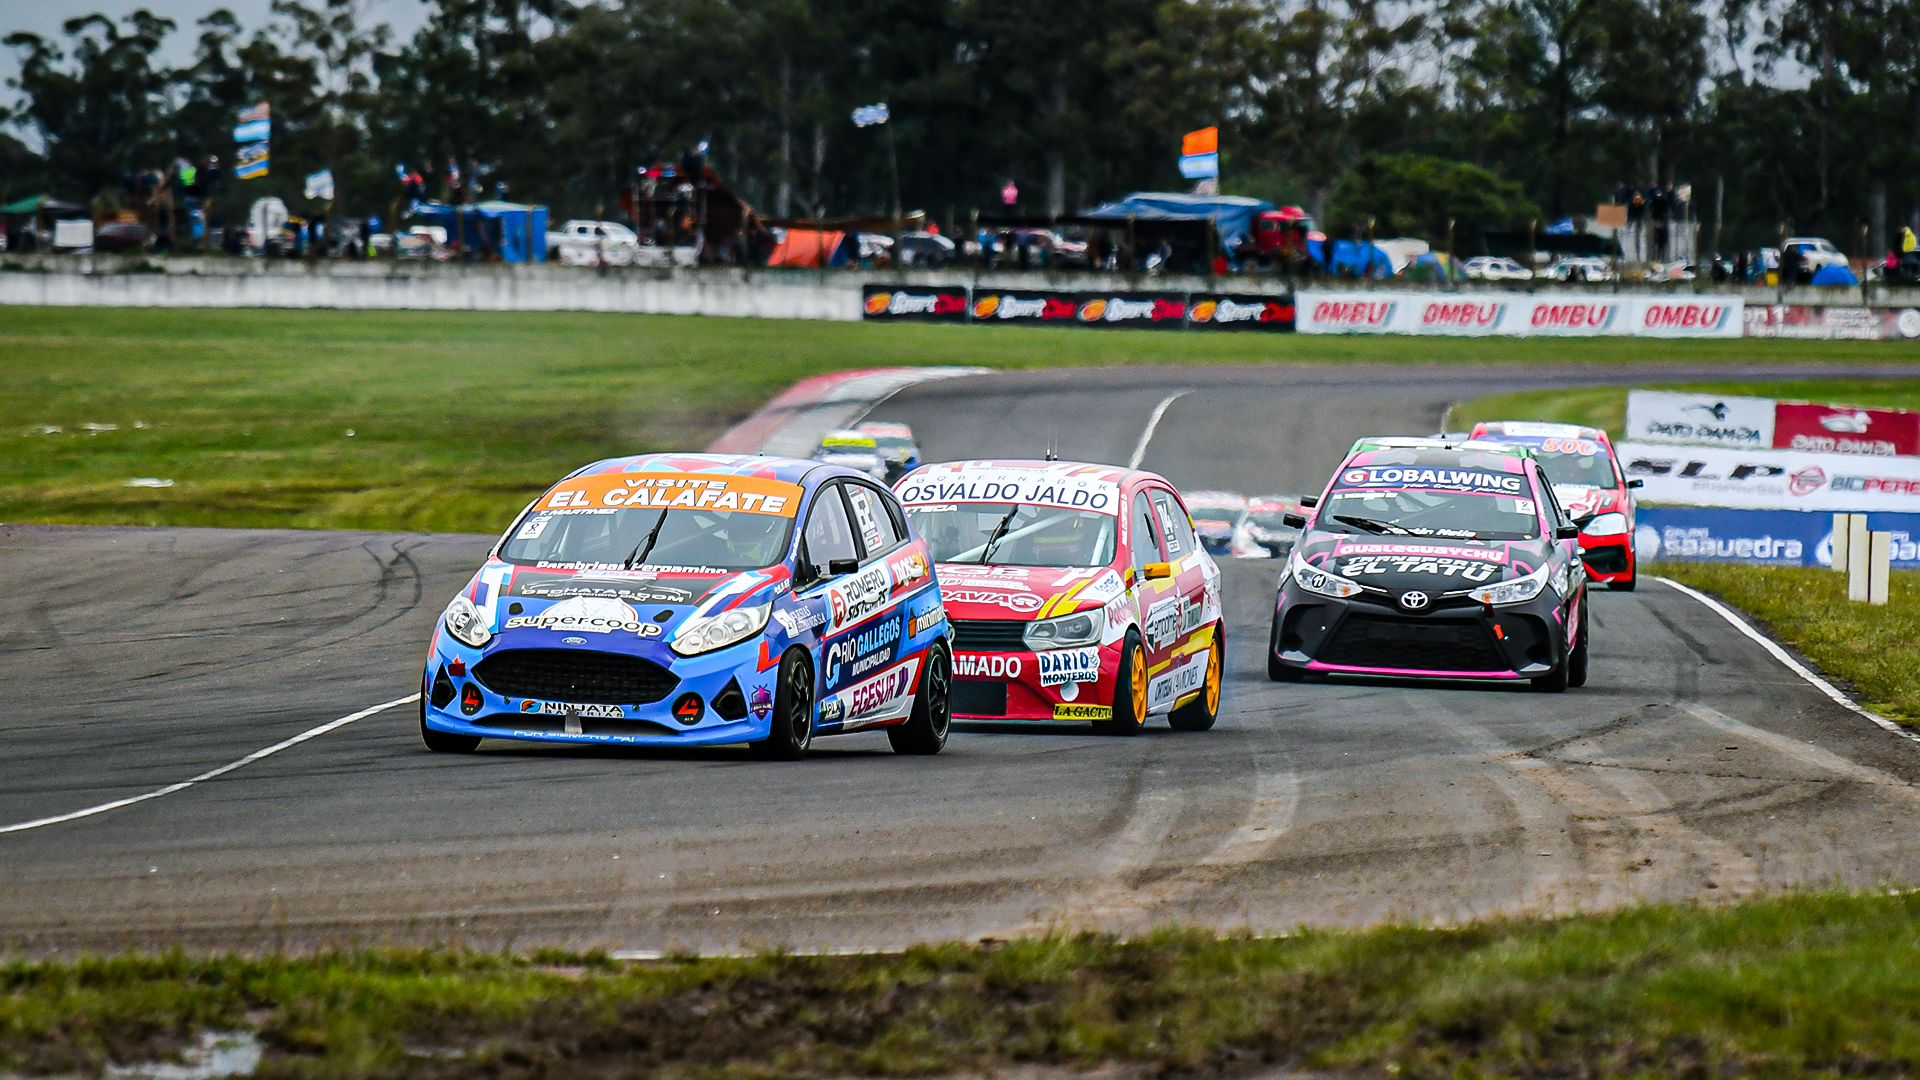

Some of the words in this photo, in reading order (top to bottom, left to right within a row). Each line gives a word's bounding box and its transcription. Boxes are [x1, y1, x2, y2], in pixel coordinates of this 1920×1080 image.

[1313, 302, 1388, 325] OMBU
[1423, 303, 1498, 326] OMBU
[1531, 304, 1607, 328] OMBU
[1644, 305, 1721, 329] OMBU
[624, 479, 729, 490] VISITE
[916, 475, 1108, 491] GOBERNADOR
[1344, 469, 1521, 491] GLOBALWING
[546, 490, 591, 508] EL
[602, 488, 788, 513] CALAFATE
[902, 483, 1020, 503] OSVALDO
[1025, 485, 1109, 509] JALDO
[1340, 560, 1385, 577] EL
[1347, 555, 1500, 572] TRANSPORTE
[843, 568, 886, 602] ROMERO
[841, 634, 857, 665] RÍO
[857, 616, 900, 657] GALLEGOS
[852, 647, 891, 677] MUNICIPALIDAD
[1041, 652, 1090, 674] DARIO
[1042, 670, 1097, 684] MONTEROS
[847, 673, 897, 718] EGESUR
[545, 702, 622, 713] NINJATA
[1054, 705, 1072, 716] LA
